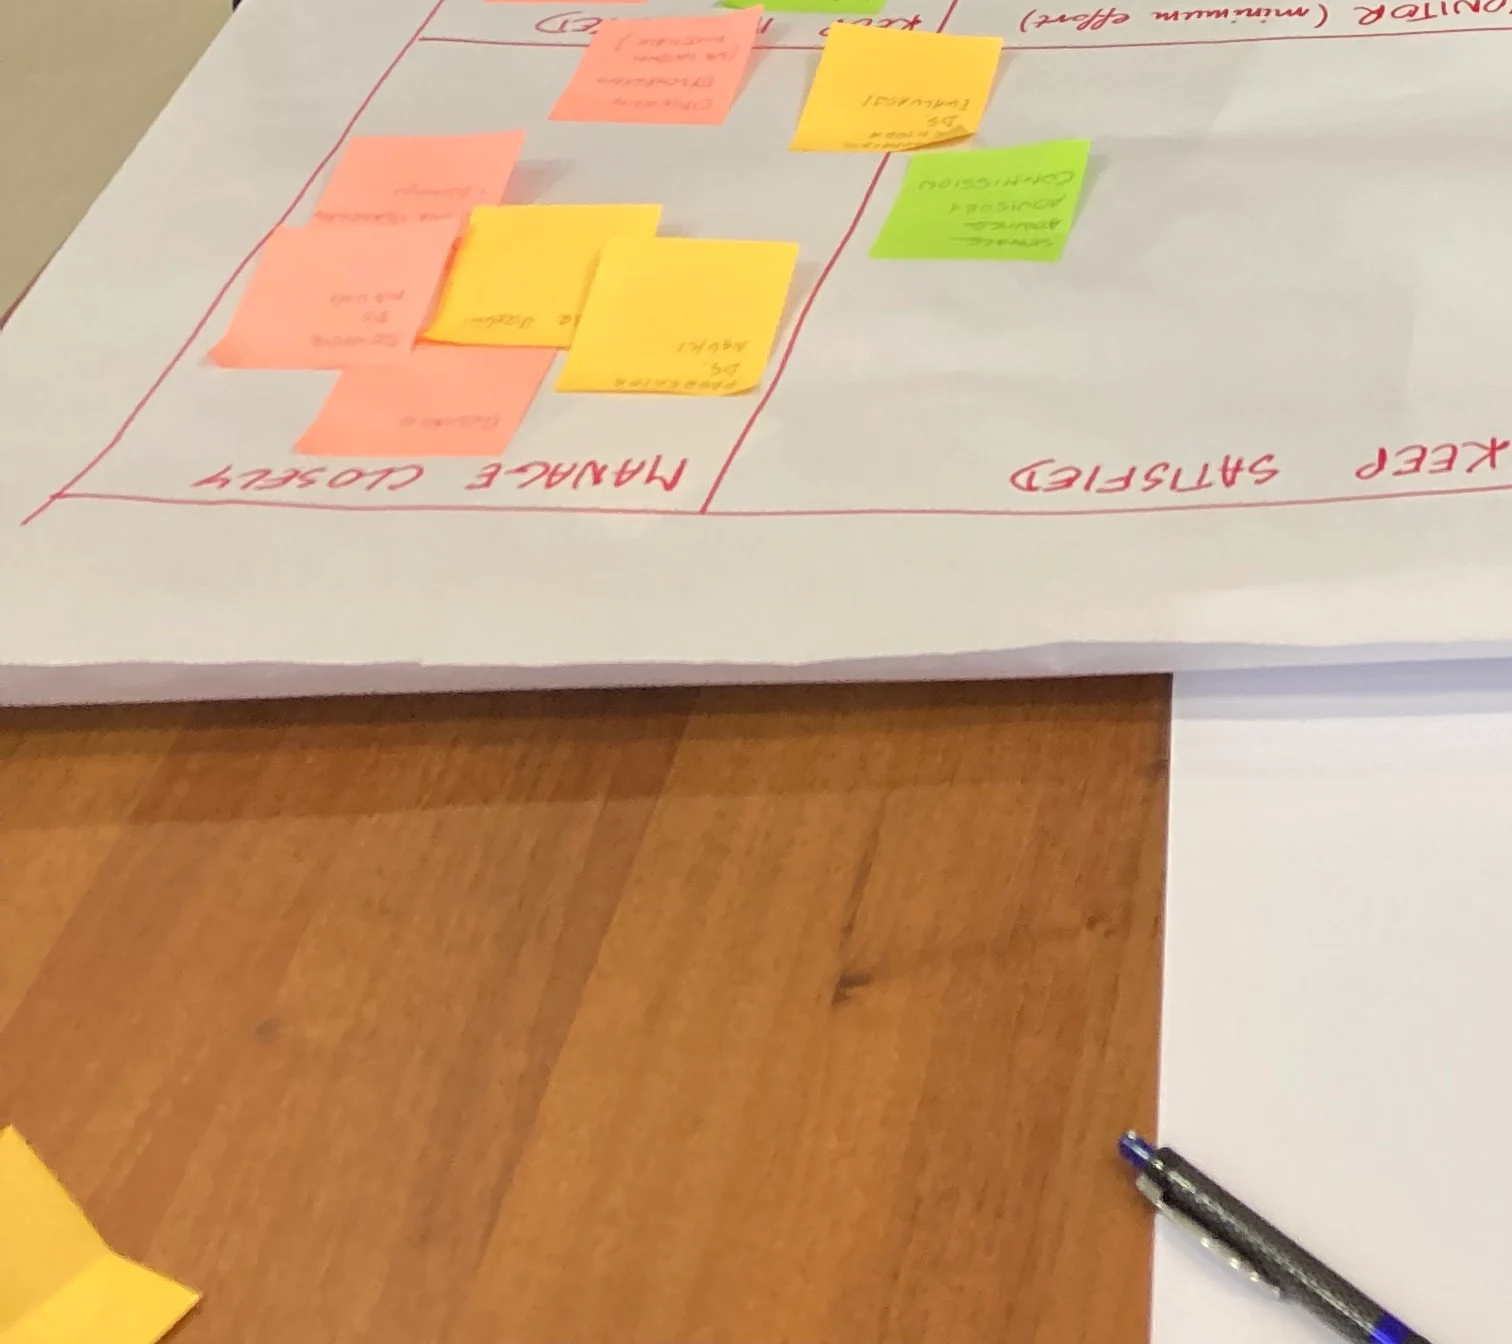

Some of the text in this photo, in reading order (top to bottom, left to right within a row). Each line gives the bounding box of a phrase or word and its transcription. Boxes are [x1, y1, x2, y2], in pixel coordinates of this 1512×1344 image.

[1018, 6, 1133, 32] effort)
[918, 170, 1075, 192] COMMISSION
[190, 453, 688, 494] MANAGE CLOSELY
[1008, 435, 1512, 494] KEEP SATISFIED
